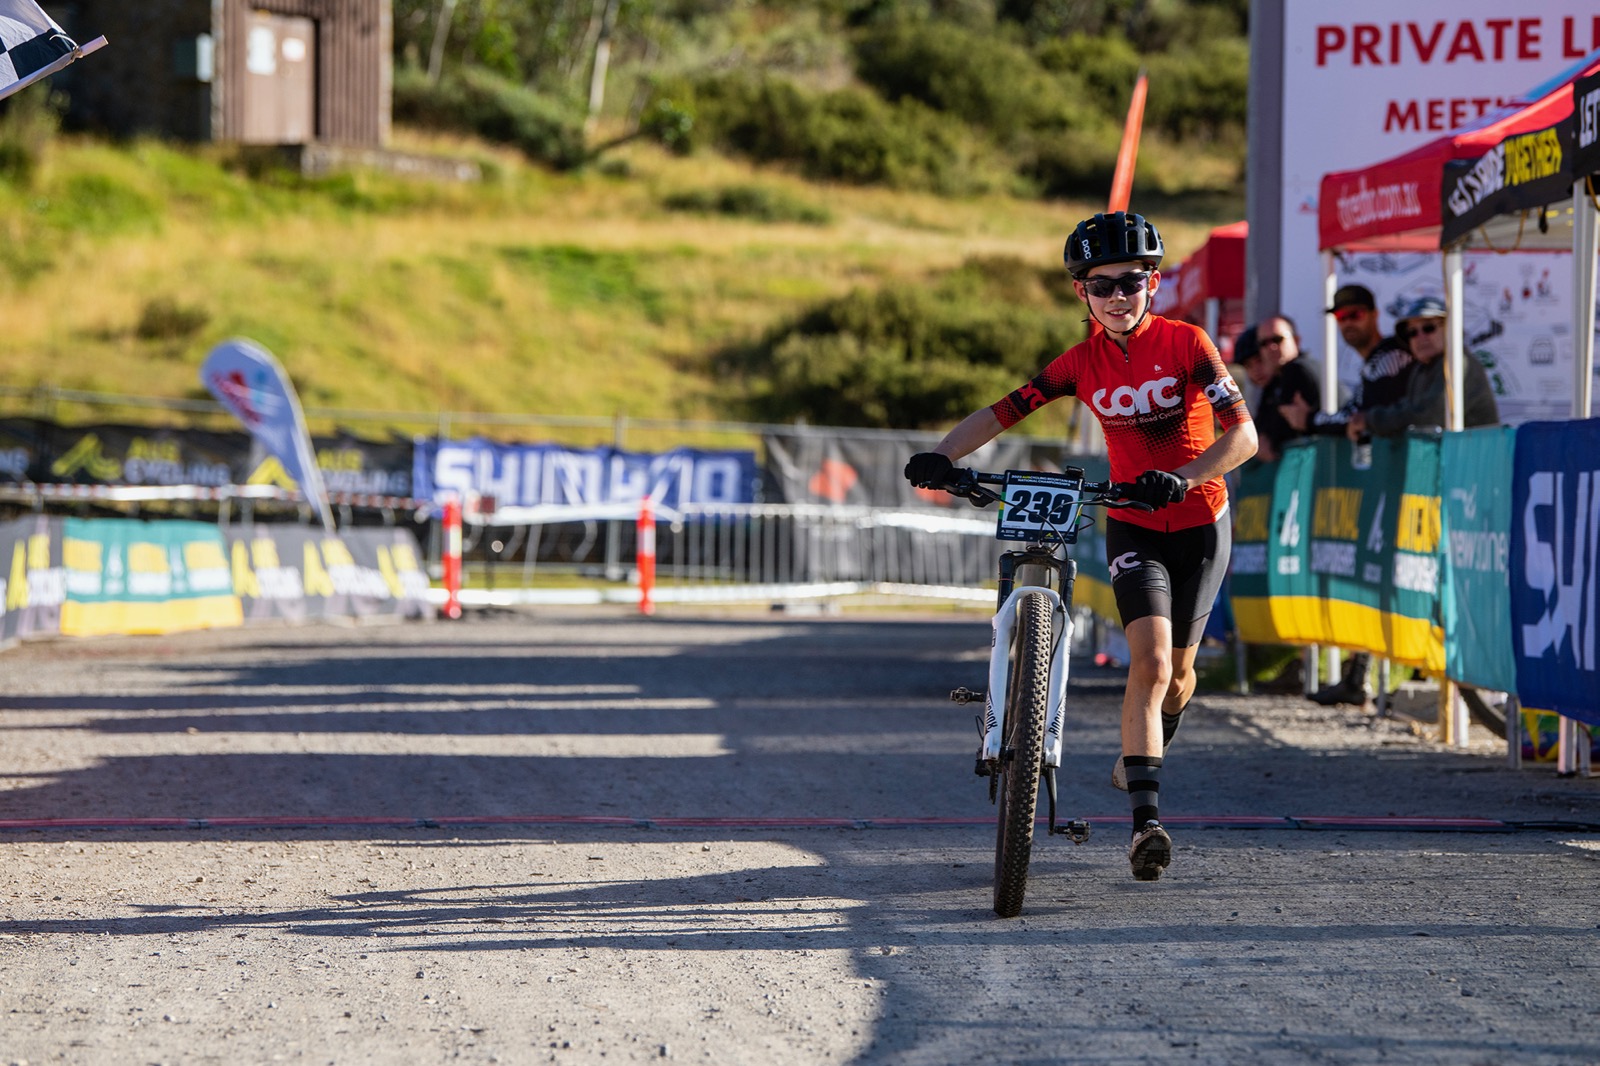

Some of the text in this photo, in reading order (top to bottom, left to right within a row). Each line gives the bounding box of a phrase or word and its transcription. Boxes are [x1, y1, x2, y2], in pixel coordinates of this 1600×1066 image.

[1315, 18, 1542, 67] PRIVATE
[1384, 98, 1506, 133] MEET
[1007, 490, 1074, 525] 239
